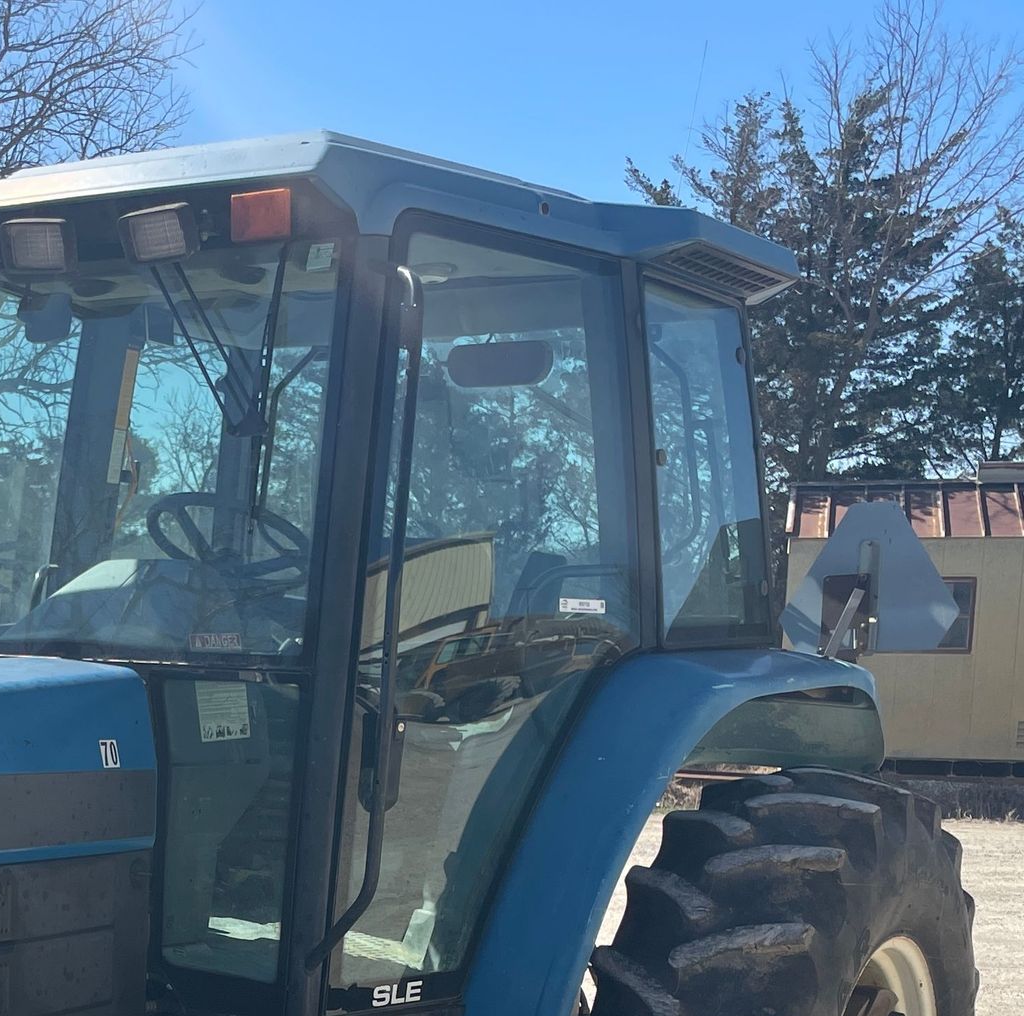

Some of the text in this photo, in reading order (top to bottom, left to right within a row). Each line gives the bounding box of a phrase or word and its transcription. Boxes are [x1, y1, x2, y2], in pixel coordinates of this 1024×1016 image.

[205, 634, 238, 649] DANGER
[100, 741, 118, 766] 70
[372, 980, 423, 1007] SLE
